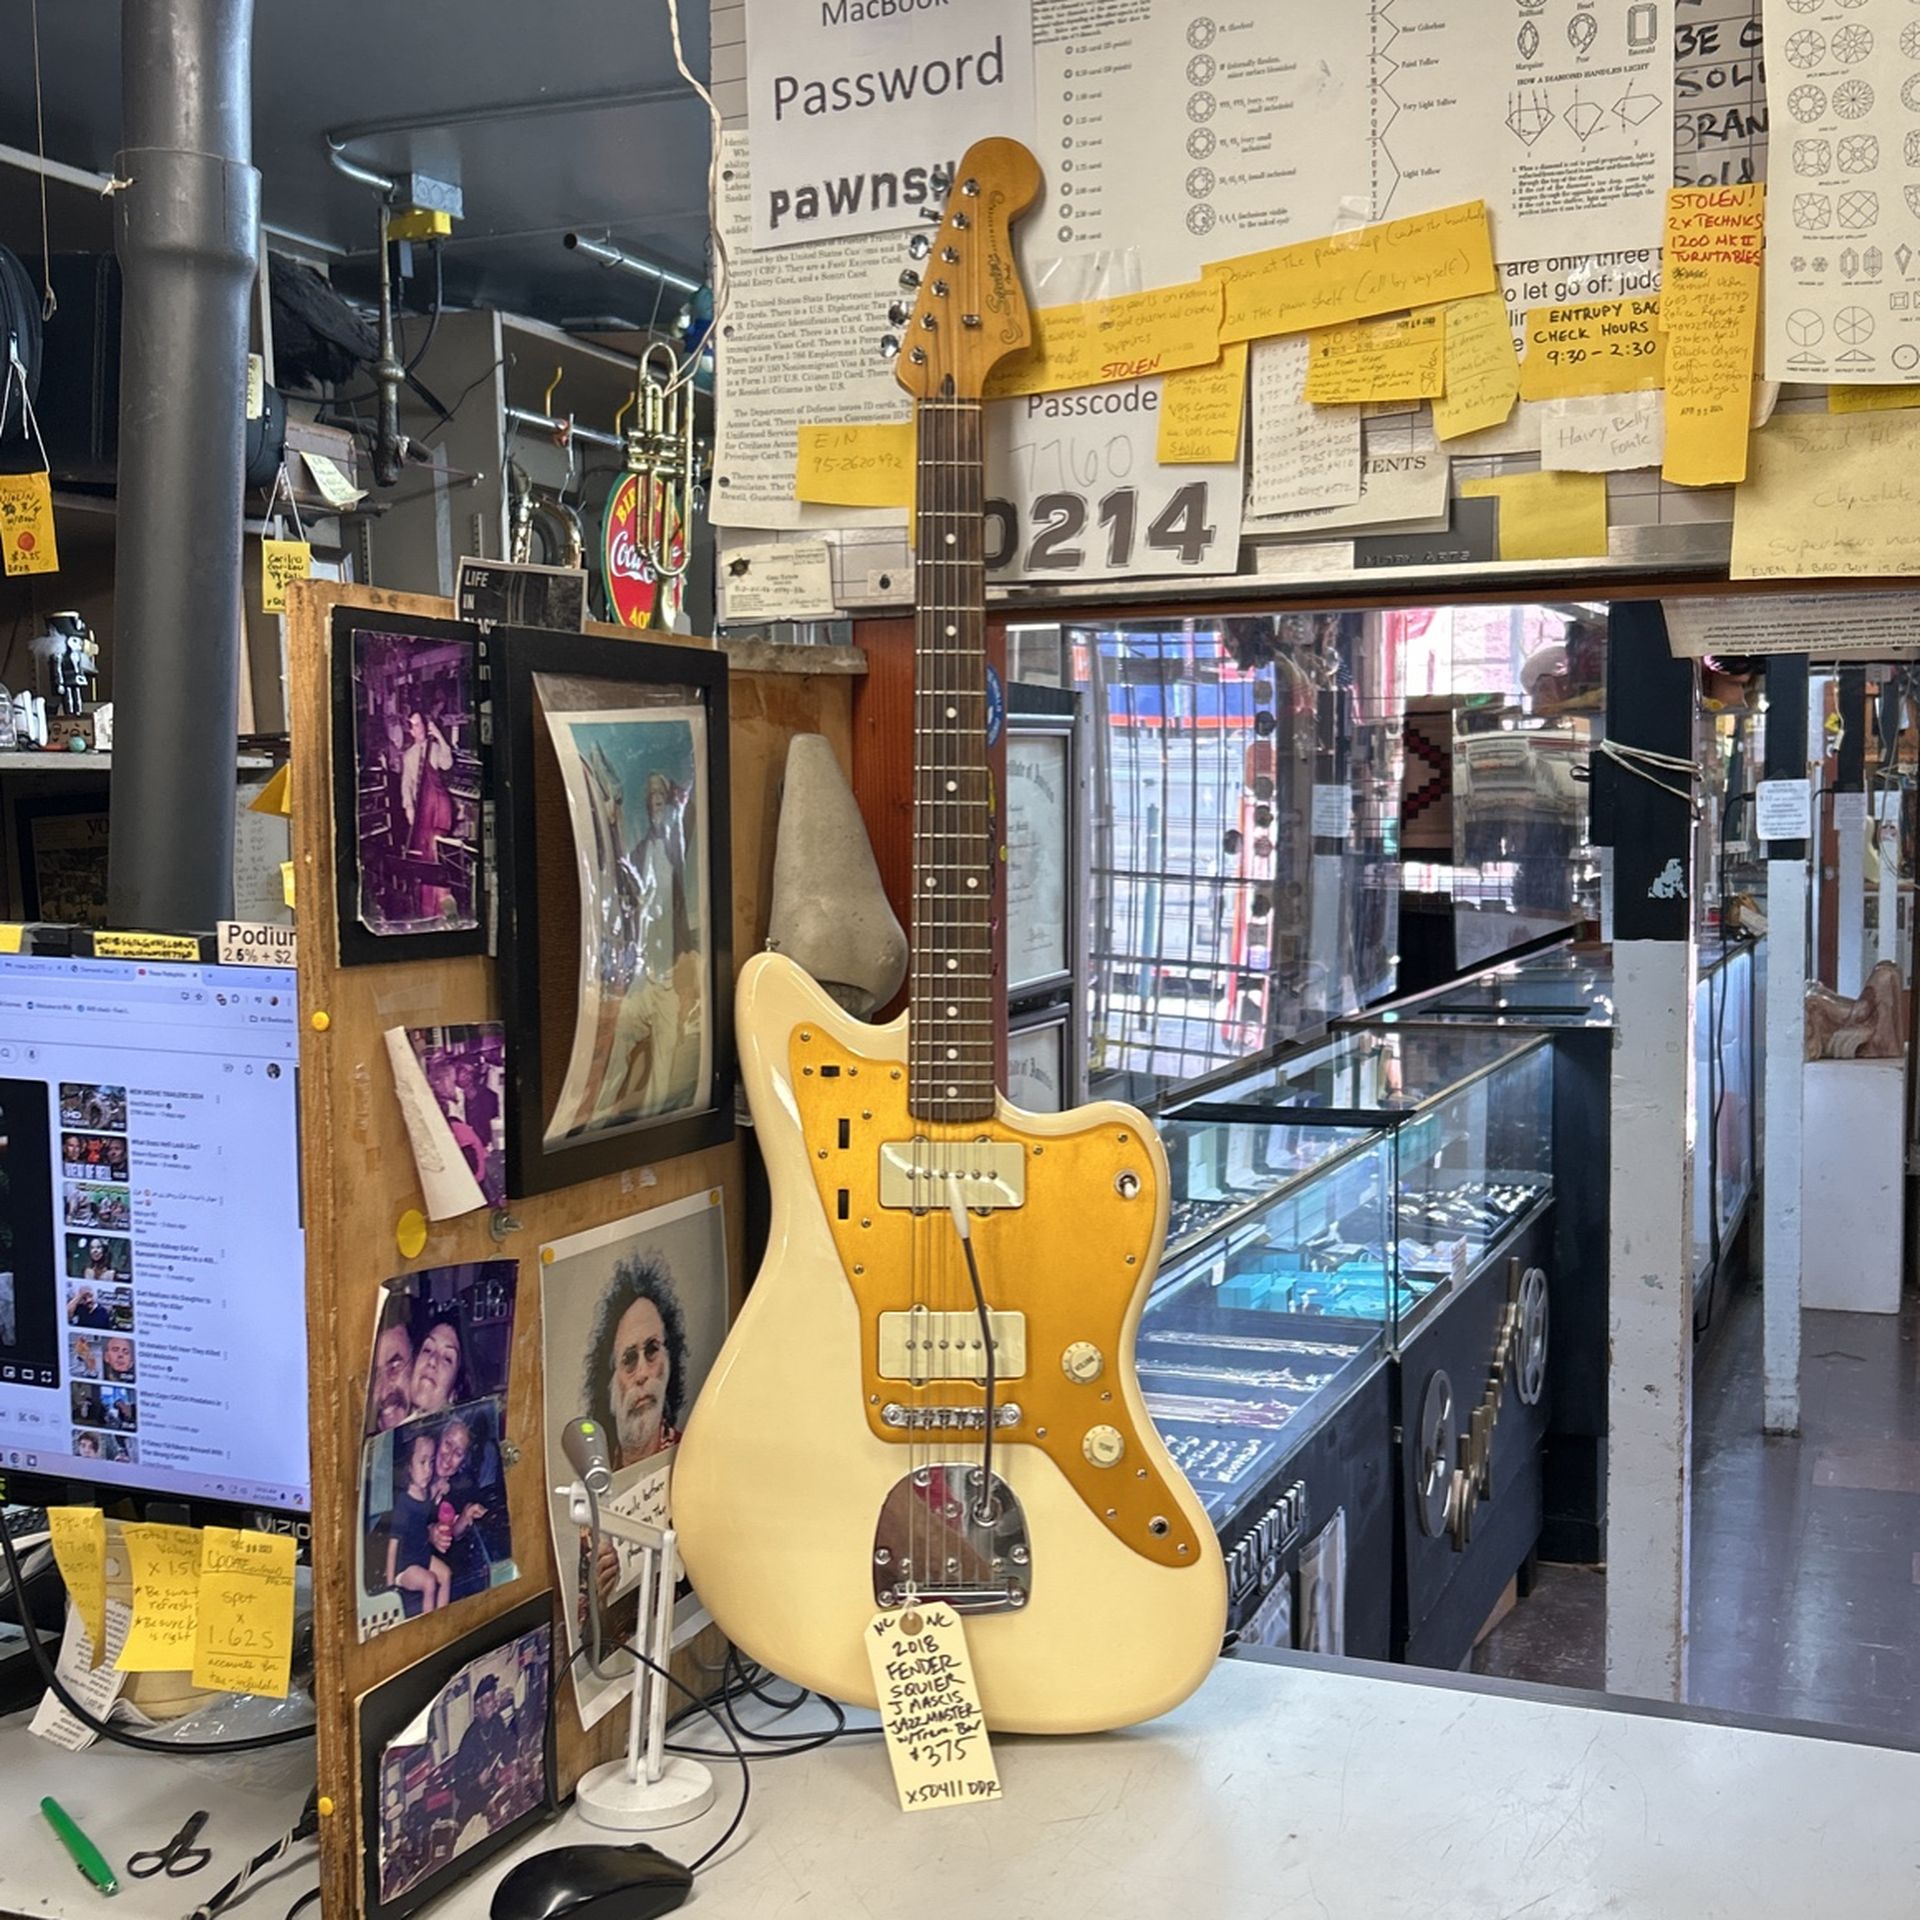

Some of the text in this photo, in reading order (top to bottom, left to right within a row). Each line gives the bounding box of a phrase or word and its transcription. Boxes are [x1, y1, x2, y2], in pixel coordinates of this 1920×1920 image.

[774, 35, 1004, 120] Password
[1671, 185, 1755, 209] STOLEN!
[1672, 234, 1710, 248] 1200
[1507, 258, 1539, 277] are
[1523, 281, 1547, 300] let
[1555, 281, 1580, 302] go
[1587, 274, 1613, 294] of:
[1550, 303, 1623, 323] ENTRUPY
[1534, 321, 1649, 344] CHECK HOURS
[1547, 340, 1656, 366] 9:30 2:30
[1101, 353, 1161, 379] STOLEN
[1028, 384, 1158, 419] Passcode
[465, 570, 489, 587] LIFE
[256, 1514, 311, 1540] VIZIO
[892, 1635, 940, 1657] 2018
[886, 1654, 962, 1681] FENDER
[890, 1673, 965, 1698] SQUIER
[888, 1690, 963, 1715] J MASCIS
[886, 1703, 983, 1735] JAZZMASTER
[909, 1735, 978, 1768] $375
